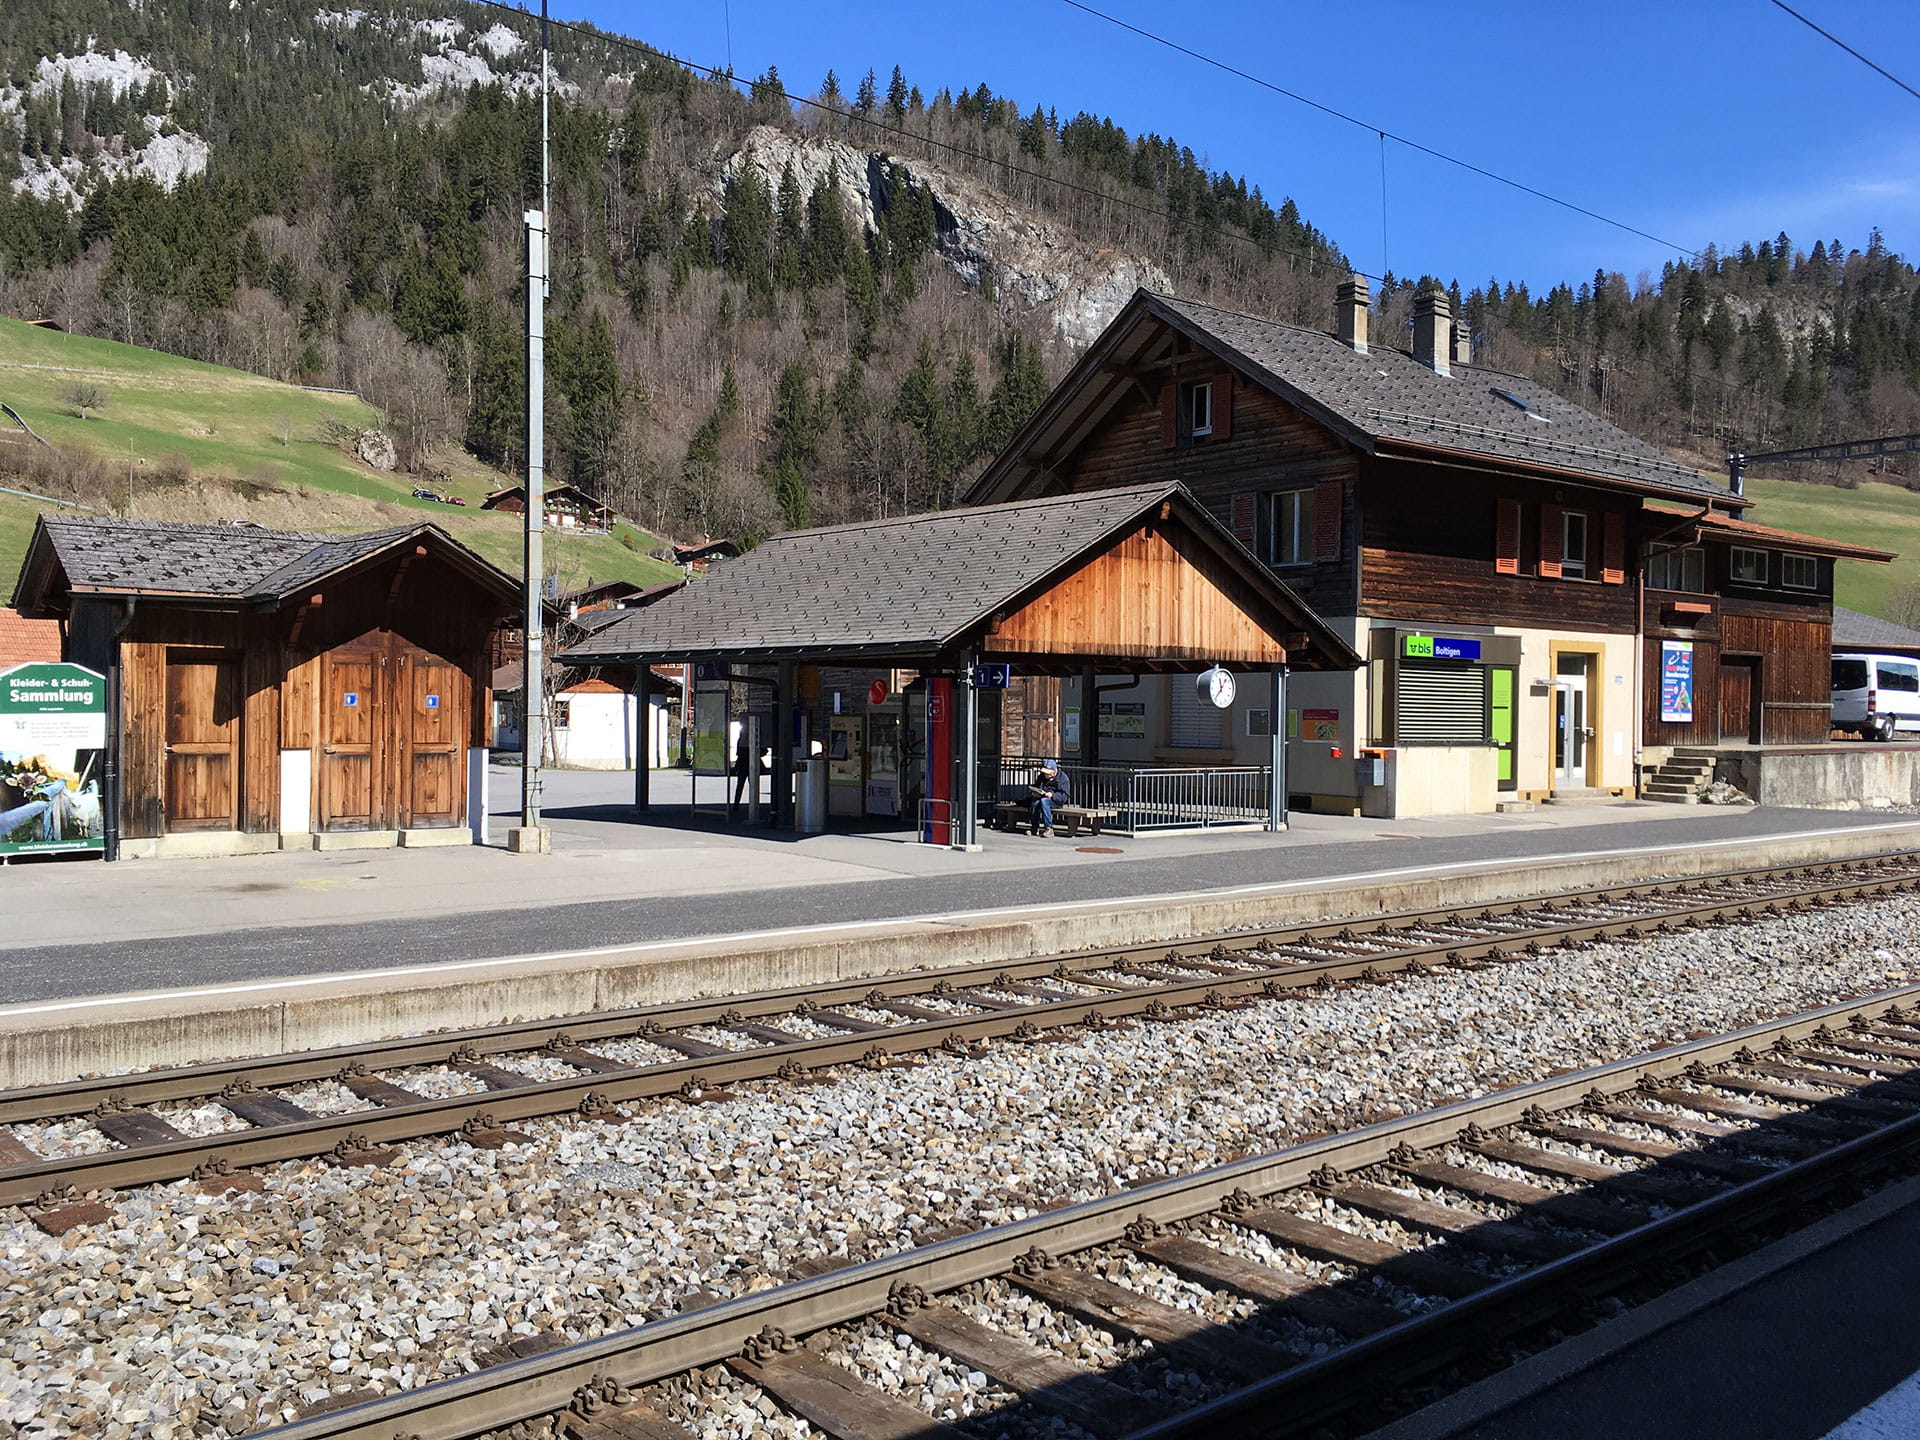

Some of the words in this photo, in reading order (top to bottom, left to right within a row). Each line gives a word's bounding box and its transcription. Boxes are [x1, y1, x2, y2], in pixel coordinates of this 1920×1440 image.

[1418, 644, 1431, 654] bls
[1435, 646, 1460, 657] Boltigen
[697, 665, 704, 678] 0
[10, 679, 48, 687] Kleider-
[51, 679, 59, 687] &
[61, 679, 93, 687] Schuh-
[10, 689, 93, 704] Sammlung
